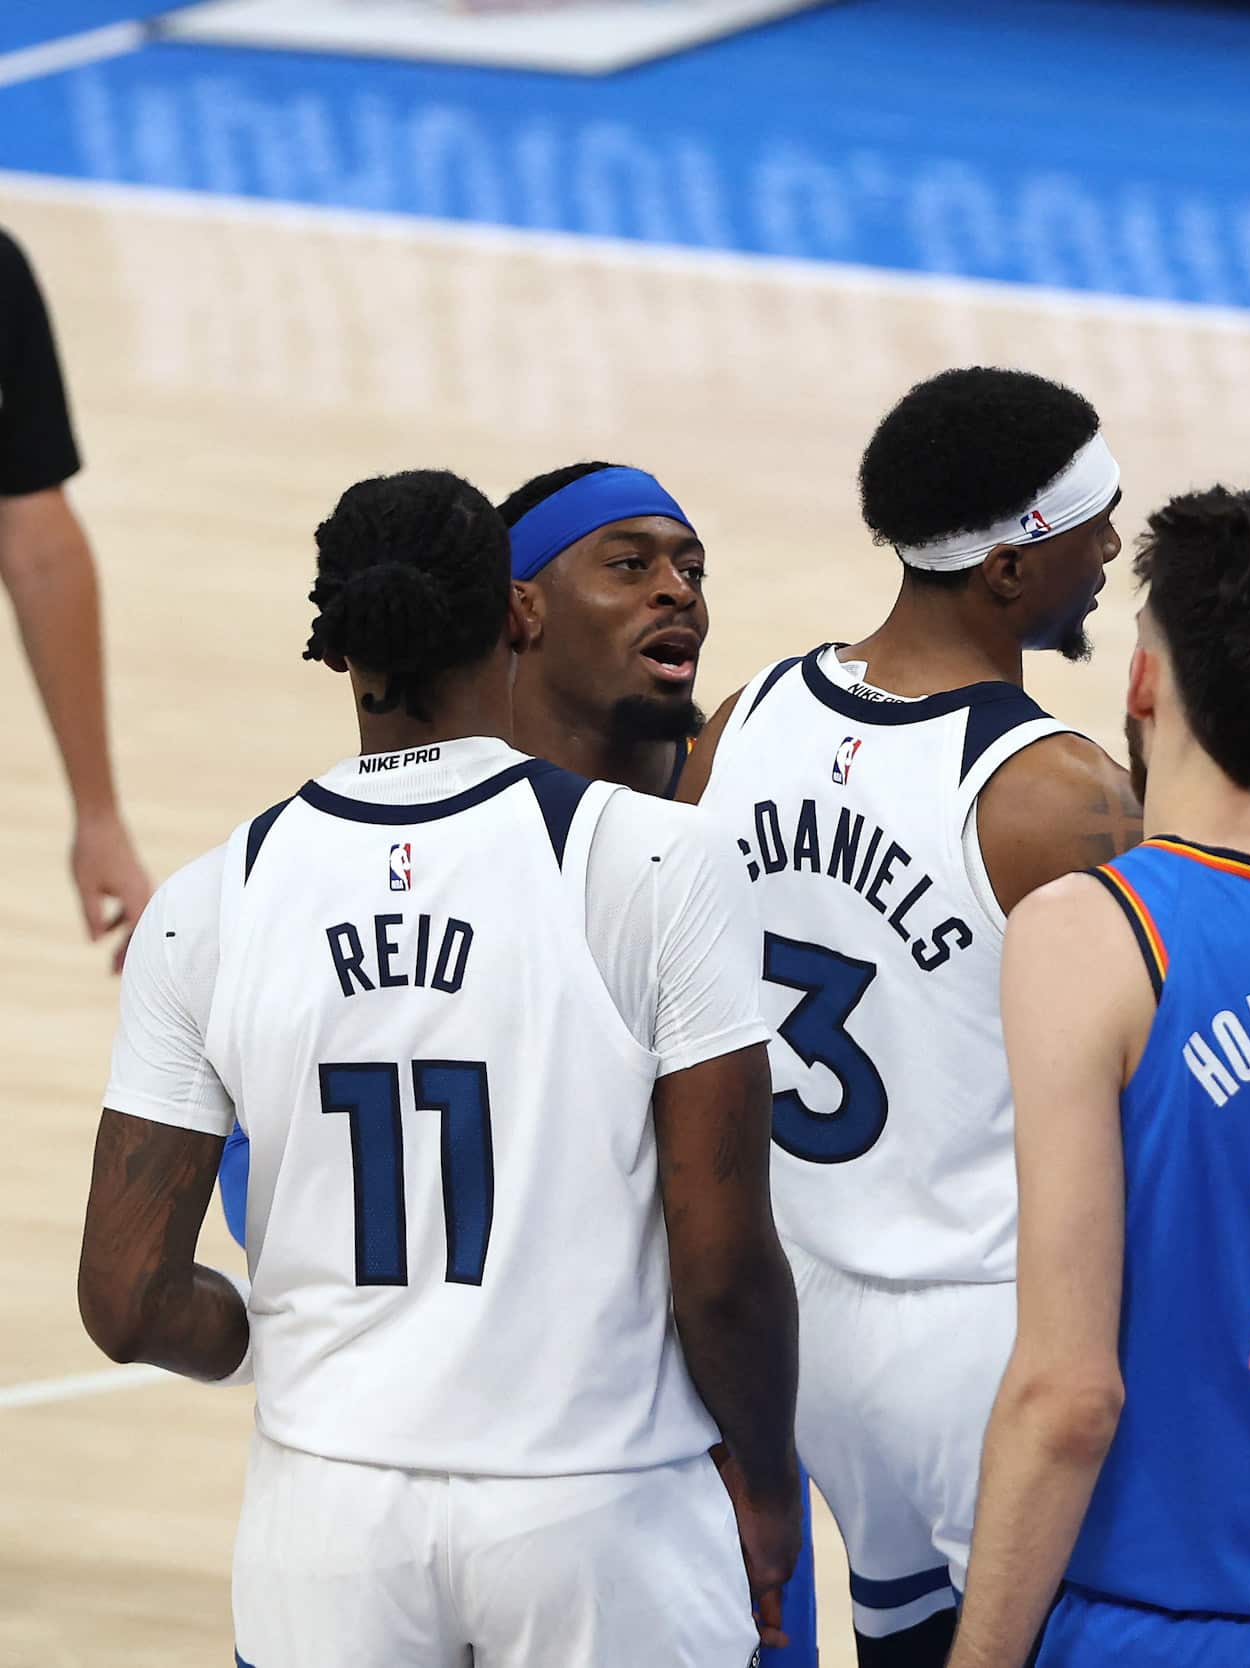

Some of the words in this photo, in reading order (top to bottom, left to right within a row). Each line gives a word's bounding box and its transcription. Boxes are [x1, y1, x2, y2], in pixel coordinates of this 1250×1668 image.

[359, 755, 400, 774] NIKE
[403, 747, 440, 767] PRO
[326, 913, 474, 997] REID
[762, 930, 889, 1164] 3
[318, 1059, 494, 1287] 11
